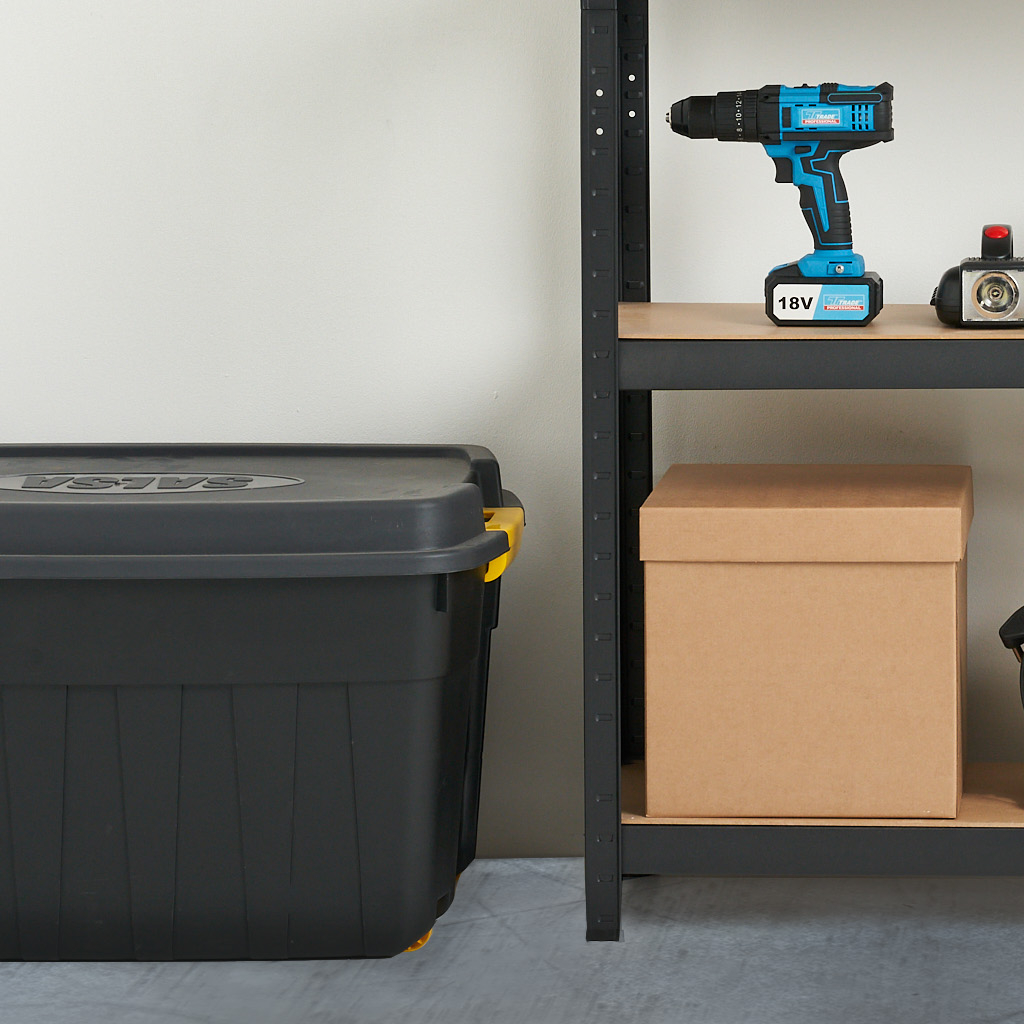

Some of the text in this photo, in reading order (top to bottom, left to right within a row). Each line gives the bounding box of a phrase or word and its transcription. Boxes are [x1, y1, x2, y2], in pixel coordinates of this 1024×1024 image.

[735, 100, 742, 108] 12
[735, 113, 742, 121] 10
[778, 297, 813, 310] 18V
[21, 476, 253, 489] SALSA
